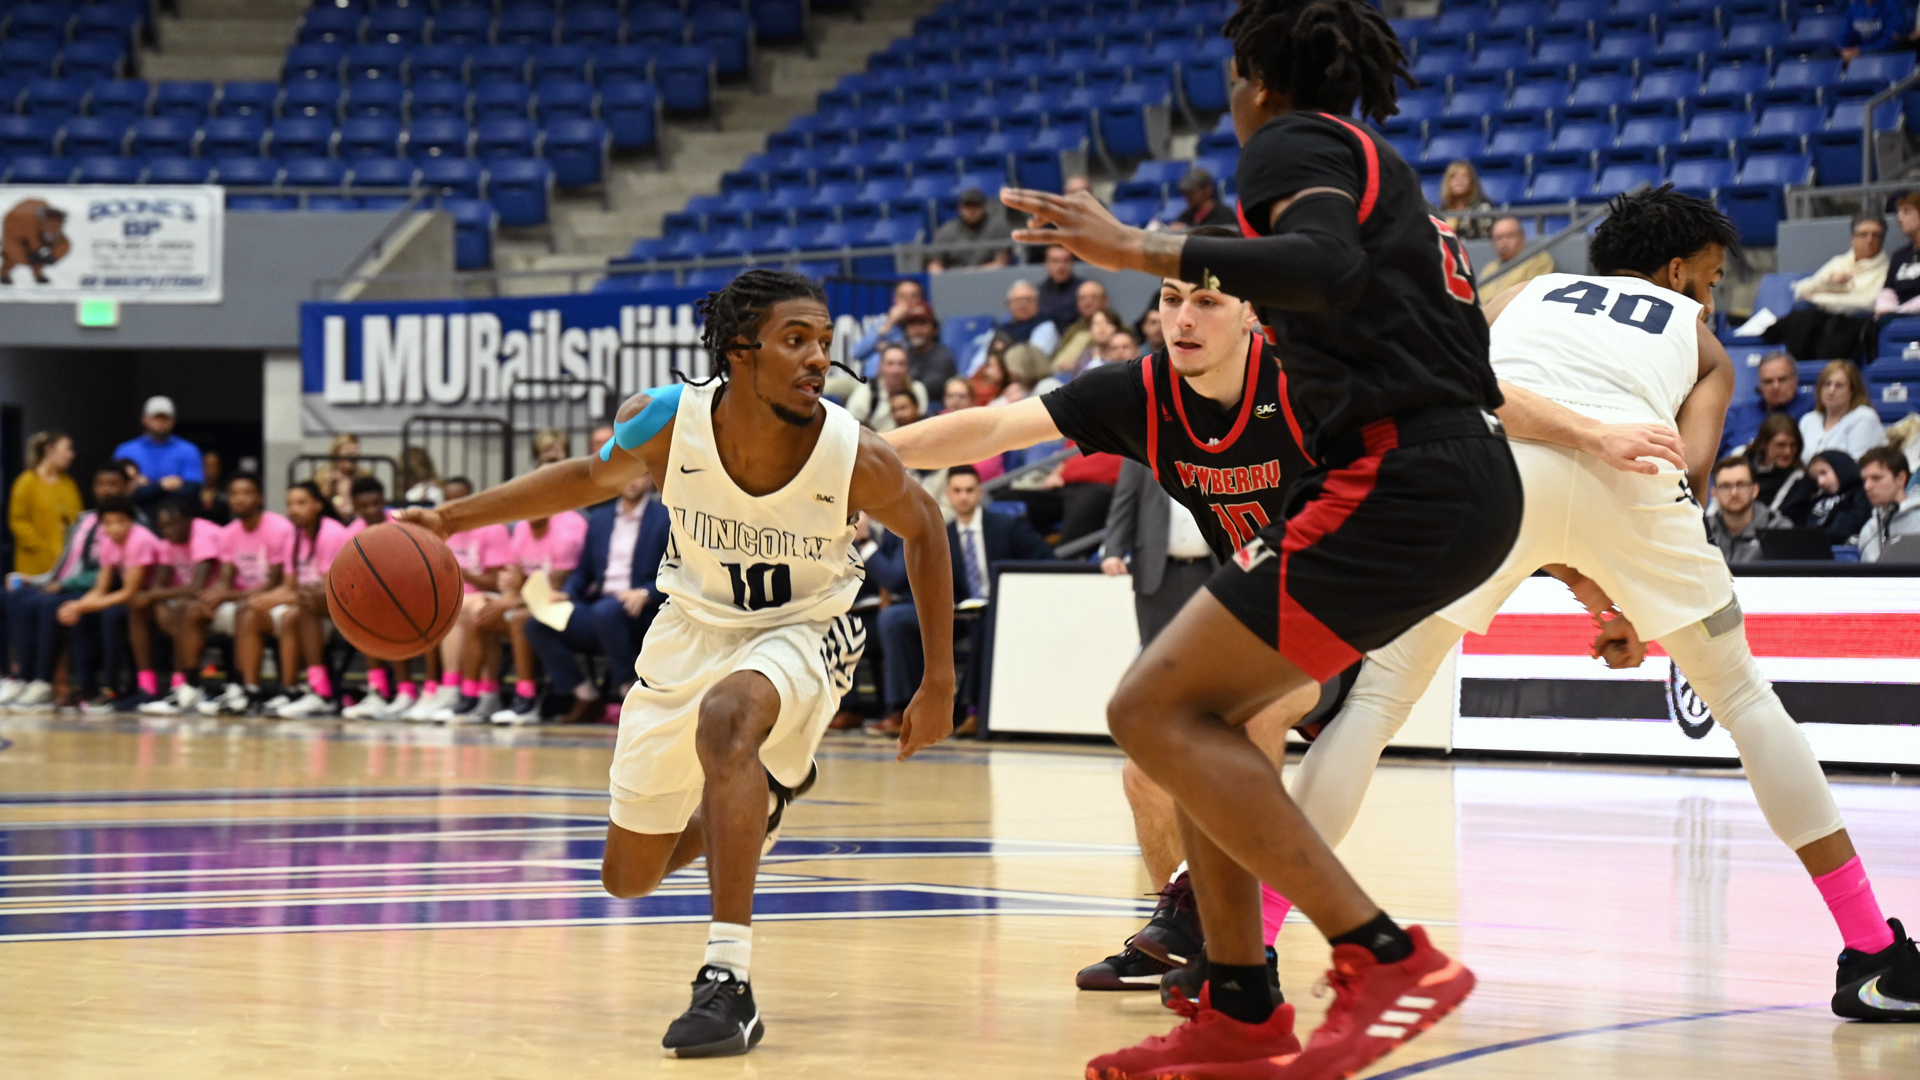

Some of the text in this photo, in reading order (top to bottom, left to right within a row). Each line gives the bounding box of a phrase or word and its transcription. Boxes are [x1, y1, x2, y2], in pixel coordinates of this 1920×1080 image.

[1542, 280, 1674, 335] 40
[323, 304, 716, 418] LMURailsplitt
[1256, 403, 1277, 415] SAC
[816, 493, 835, 504] SAC
[1174, 459, 1281, 497] NEWBERRY
[1209, 501, 1271, 555] 10
[720, 562, 792, 611] 10
